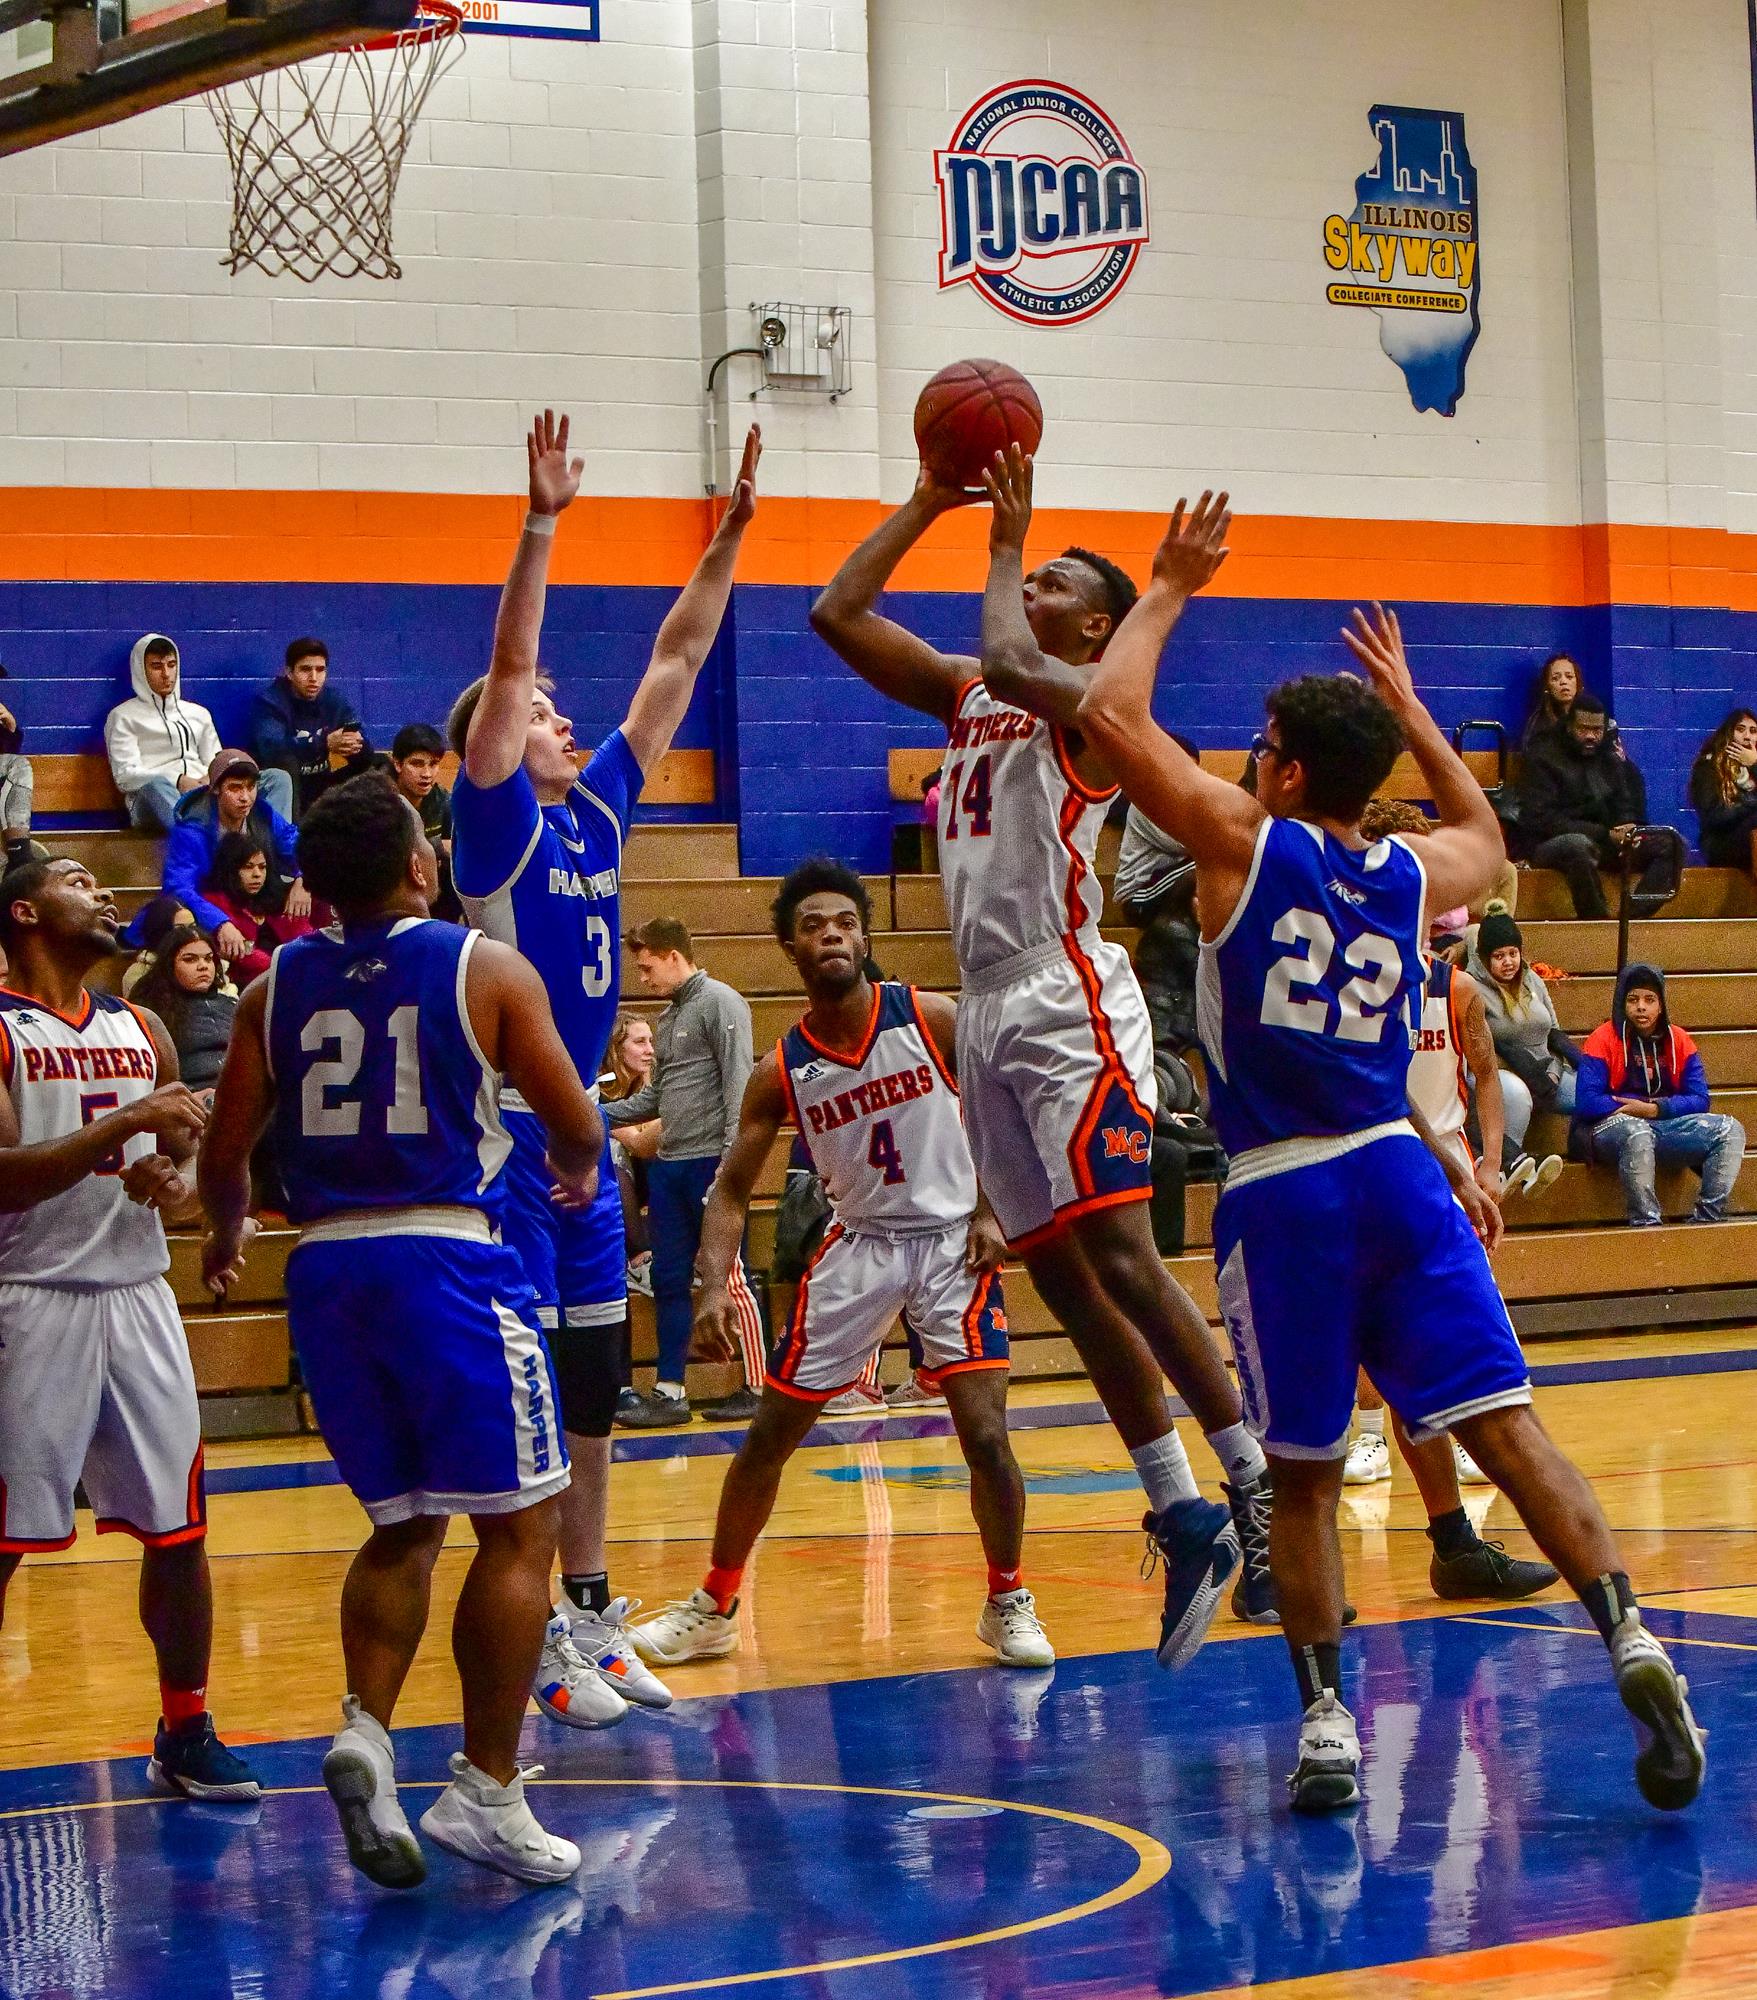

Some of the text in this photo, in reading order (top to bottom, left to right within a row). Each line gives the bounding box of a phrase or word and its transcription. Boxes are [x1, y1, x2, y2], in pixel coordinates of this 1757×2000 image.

[461, 1, 498, 20] 2001
[966, 97, 1115, 155] NATIONAL JUNIOR COLLEGE
[947, 157, 1142, 270] NJCAA
[1363, 204, 1472, 234] ILLINOIS
[998, 250, 1125, 311] ATHLETIC ASSOCIATION
[1323, 214, 1478, 289] Skyway
[1334, 289, 1460, 309] COLLEGIATE CONFERENCE
[946, 754, 992, 840] 14
[549, 868, 618, 901] HARPE
[582, 916, 612, 997] 3
[1260, 907, 1403, 1043] 22
[22, 1046, 155, 1083] PANTHERS
[300, 1005, 428, 1136] 21
[805, 1064, 934, 1136] PANTHERS
[867, 1118, 906, 1186] 4
[1102, 1127, 1148, 1163] MC
[523, 1354, 549, 1474] HARPER
